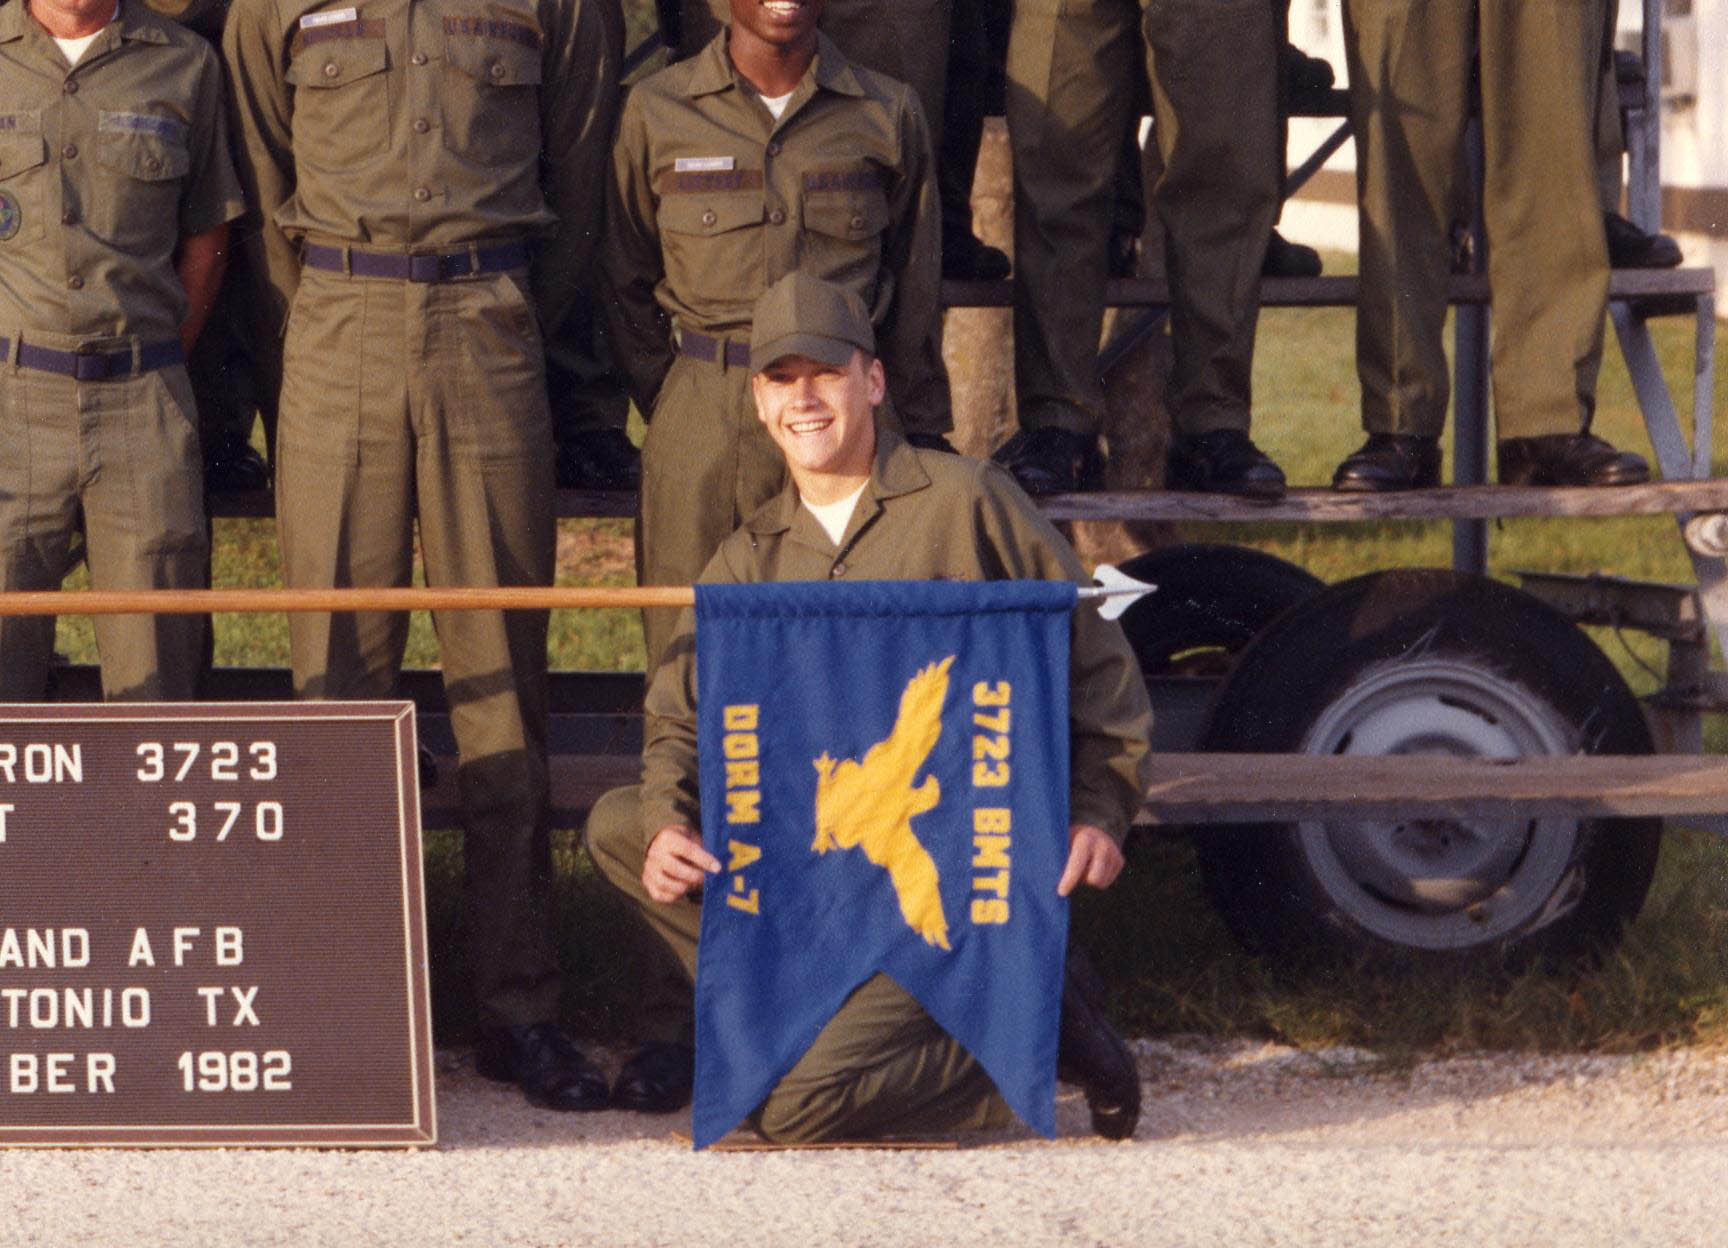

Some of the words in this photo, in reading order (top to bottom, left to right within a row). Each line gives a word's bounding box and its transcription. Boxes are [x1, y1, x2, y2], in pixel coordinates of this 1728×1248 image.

[136, 741, 277, 782] 3723
[973, 681, 1011, 787] 3723
[723, 705, 761, 824] DORM
[169, 801, 283, 841] 370
[727, 841, 761, 913] A-7
[972, 809, 1011, 925] BMTS
[197, 986, 260, 1026] TX
[178, 1050, 292, 1092] 1982
